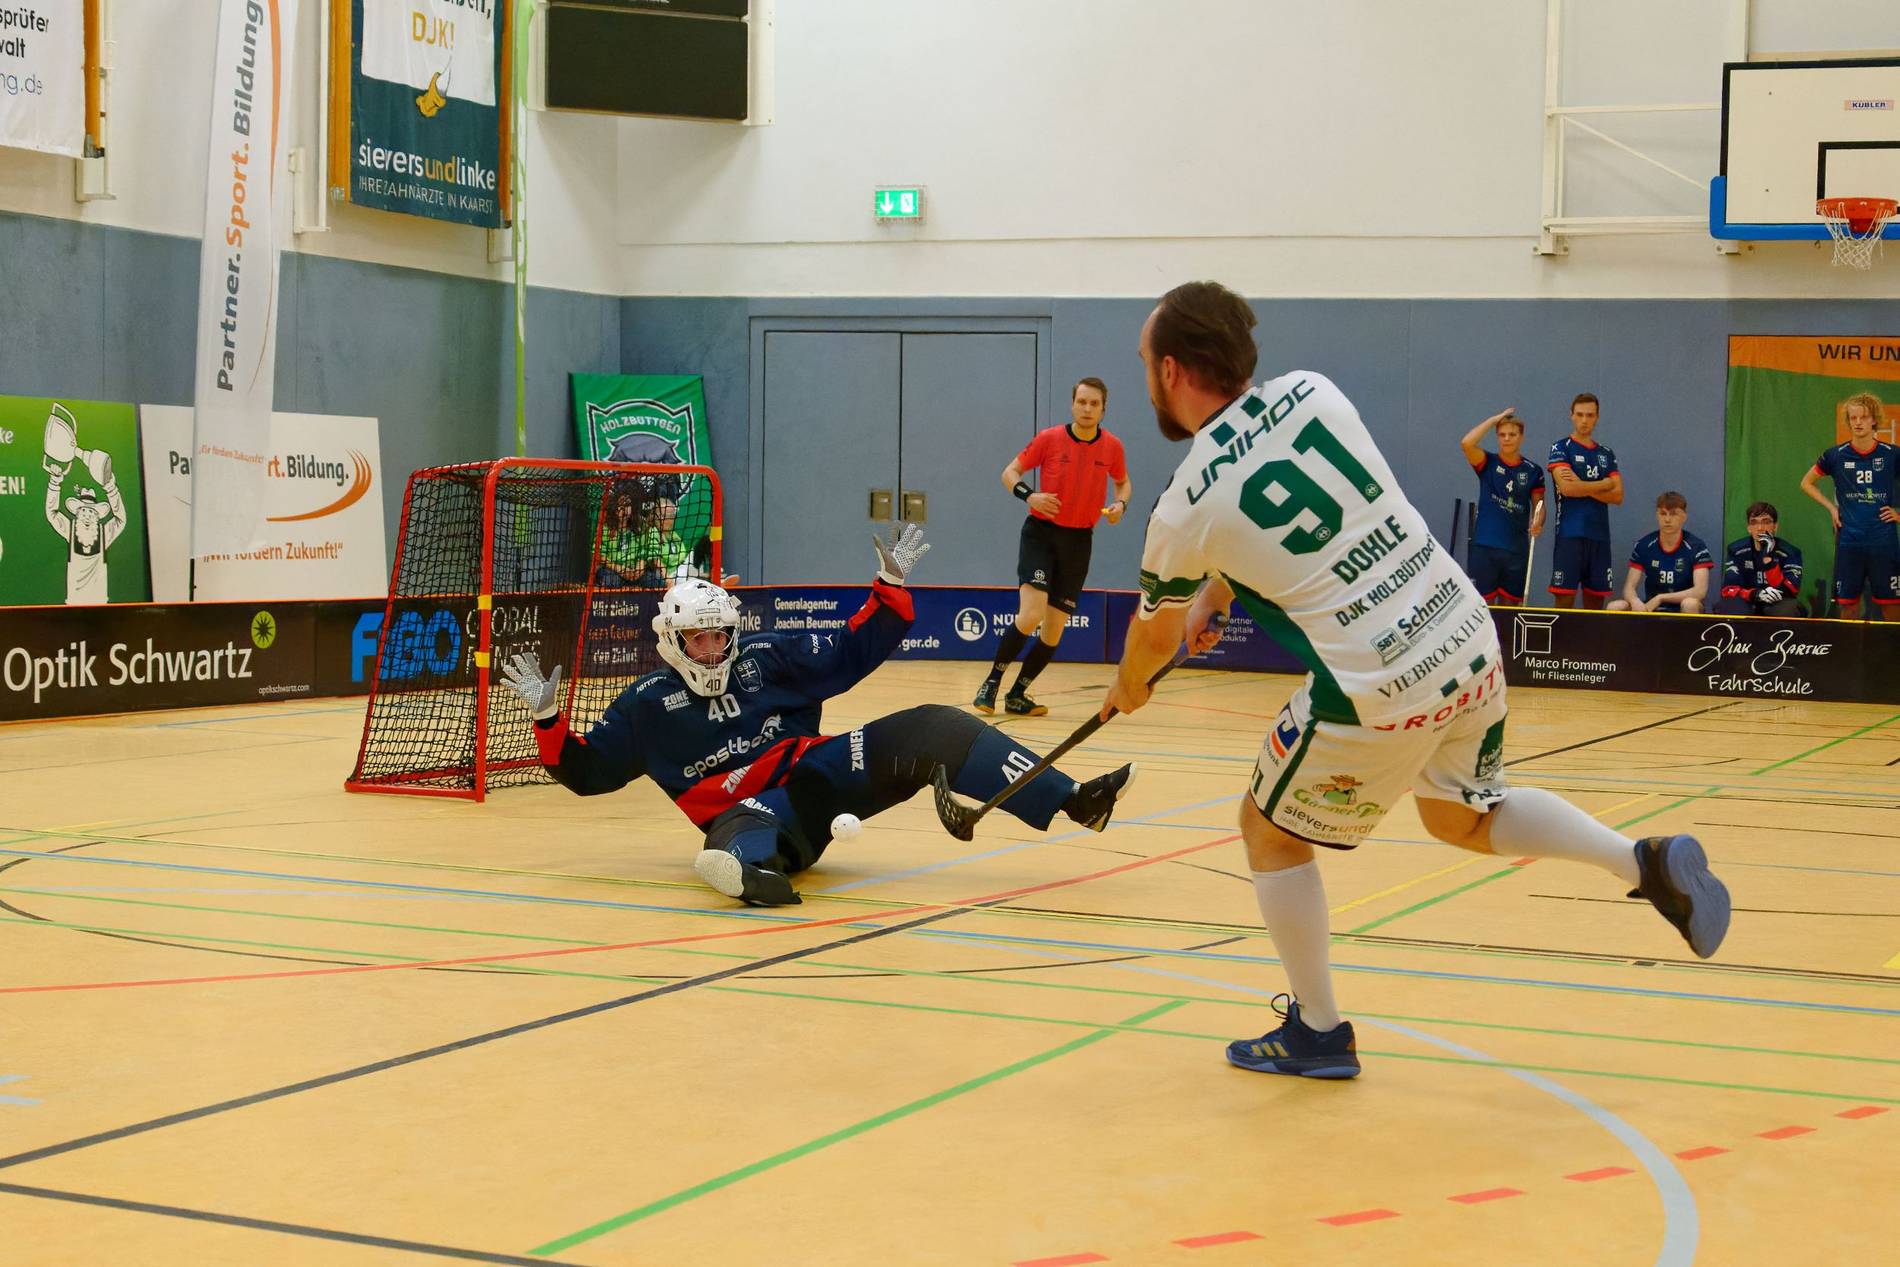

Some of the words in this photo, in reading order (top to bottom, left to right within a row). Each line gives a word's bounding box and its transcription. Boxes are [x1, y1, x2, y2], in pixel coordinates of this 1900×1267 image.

[412, 11, 455, 50] DJK!
[359, 138, 496, 191] sieversundlinke
[226, 143, 251, 250] Sport.
[1818, 343, 1861, 361] WIR
[1186, 379, 1316, 506] UNIHOC
[1586, 464, 1600, 479] 24
[1856, 470, 1873, 484] 28
[1238, 415, 1385, 556] 91
[1505, 480, 1514, 493] 4
[1331, 514, 1409, 586] DOHLE
[1659, 570, 1674, 584] 38
[774, 597, 839, 613] Generalagentur
[1335, 598, 1371, 628] DJK
[1376, 633, 1398, 652] SBT
[1397, 577, 1460, 637] Schmitz
[773, 616, 805, 630] Joachim
[1229, 617, 1254, 625] artner
[898, 635, 941, 652] ger.de
[4, 640, 98, 704] Optik
[109, 637, 253, 687] Schwartz
[1525, 656, 1560, 669] Marco
[1562, 658, 1617, 672] Frommen
[705, 678, 721, 693] 40
[1532, 670, 1546, 680] Ihr
[1548, 671, 1607, 684] Fliesenleger
[1708, 673, 1814, 695] Fahrschule
[708, 693, 742, 723] 40
[683, 735, 775, 779] epostbox
[1001, 750, 1036, 785] 40
